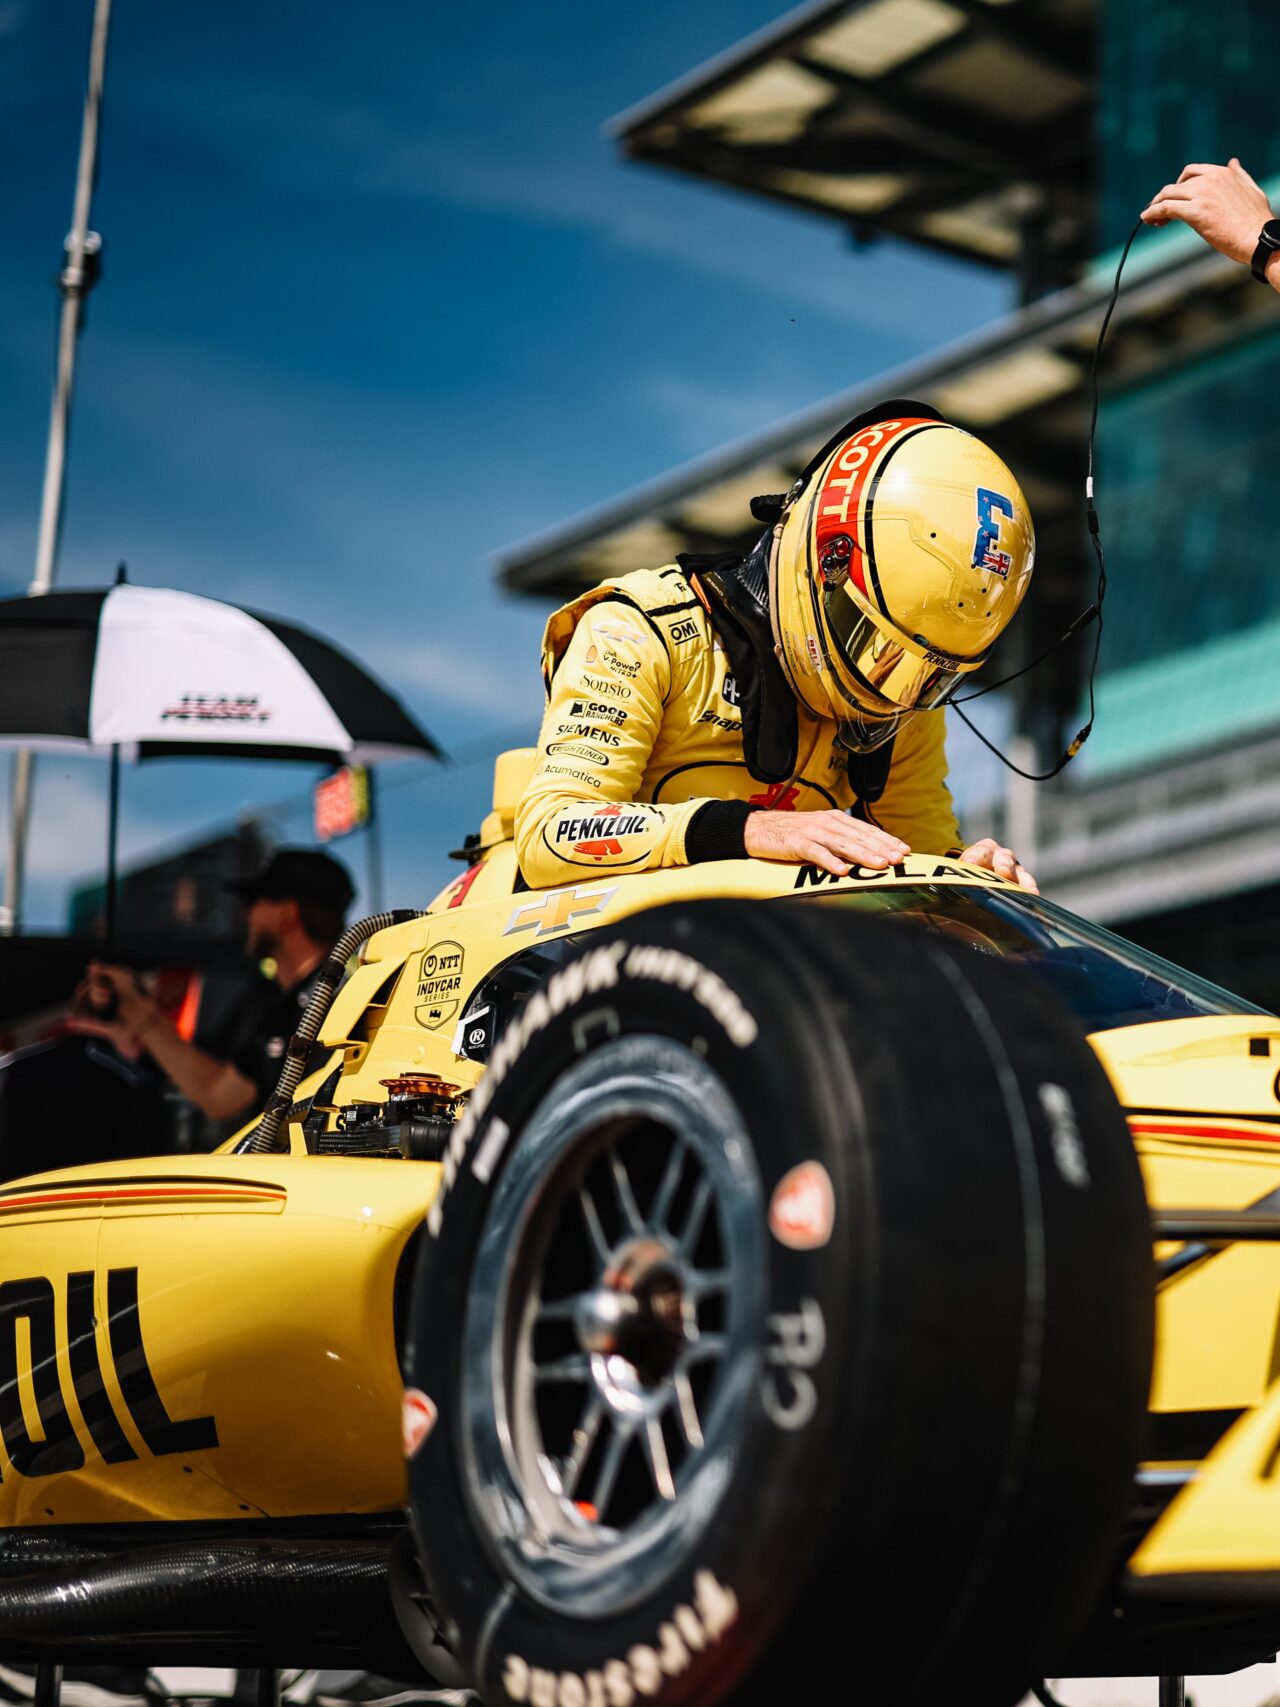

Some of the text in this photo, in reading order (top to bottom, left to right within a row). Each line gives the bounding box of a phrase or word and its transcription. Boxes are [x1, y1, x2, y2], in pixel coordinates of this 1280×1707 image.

[823, 421, 902, 523] SCOTT
[922, 651, 960, 671] PENNZOIL
[580, 674, 631, 699] Sonsio
[585, 710, 625, 727] RANCHERS
[588, 702, 628, 719] GOOD
[556, 723, 621, 747] SIEMENS
[552, 745, 604, 762] FREIGHTLINER
[544, 765, 601, 789] Acumatica
[556, 815, 647, 843] PENNZOIL
[439, 954, 460, 970] NTT
[417, 976, 461, 997] INDYCAR
[424, 991, 450, 1003] SERIES
